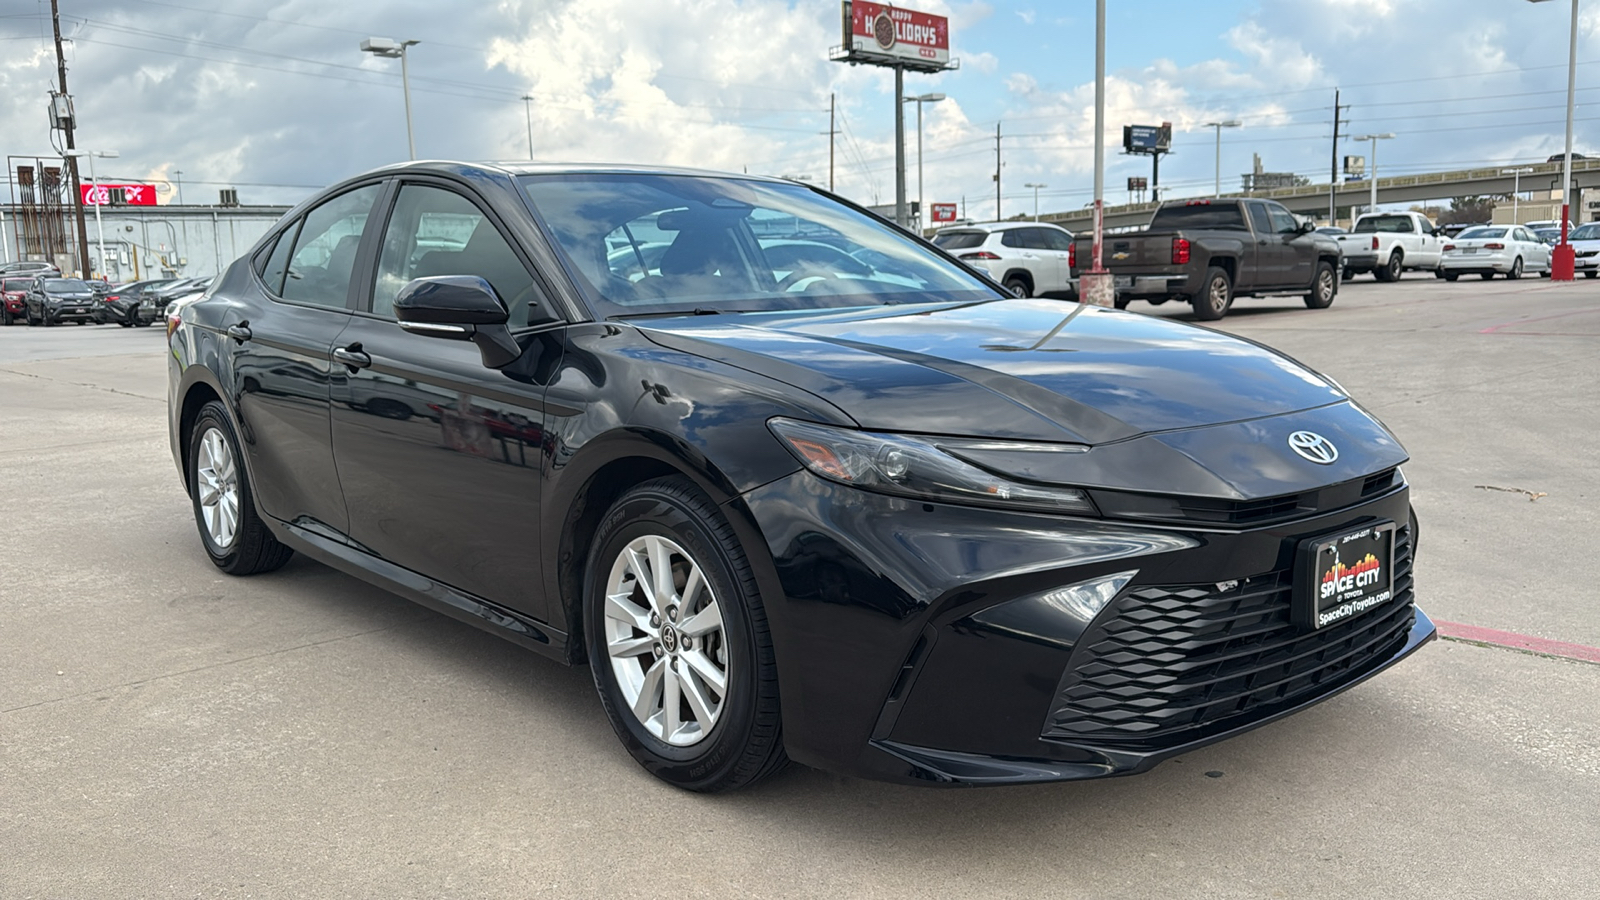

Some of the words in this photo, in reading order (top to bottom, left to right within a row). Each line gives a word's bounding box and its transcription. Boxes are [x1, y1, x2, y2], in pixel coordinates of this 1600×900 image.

[891, 10, 912, 22] HAPPY
[1320, 574, 1354, 599] SPACE
[1356, 567, 1380, 588] CITY
[1344, 589, 1363, 600] TOYOTA
[1320, 591, 1389, 625] SpaceCityToyota.com
